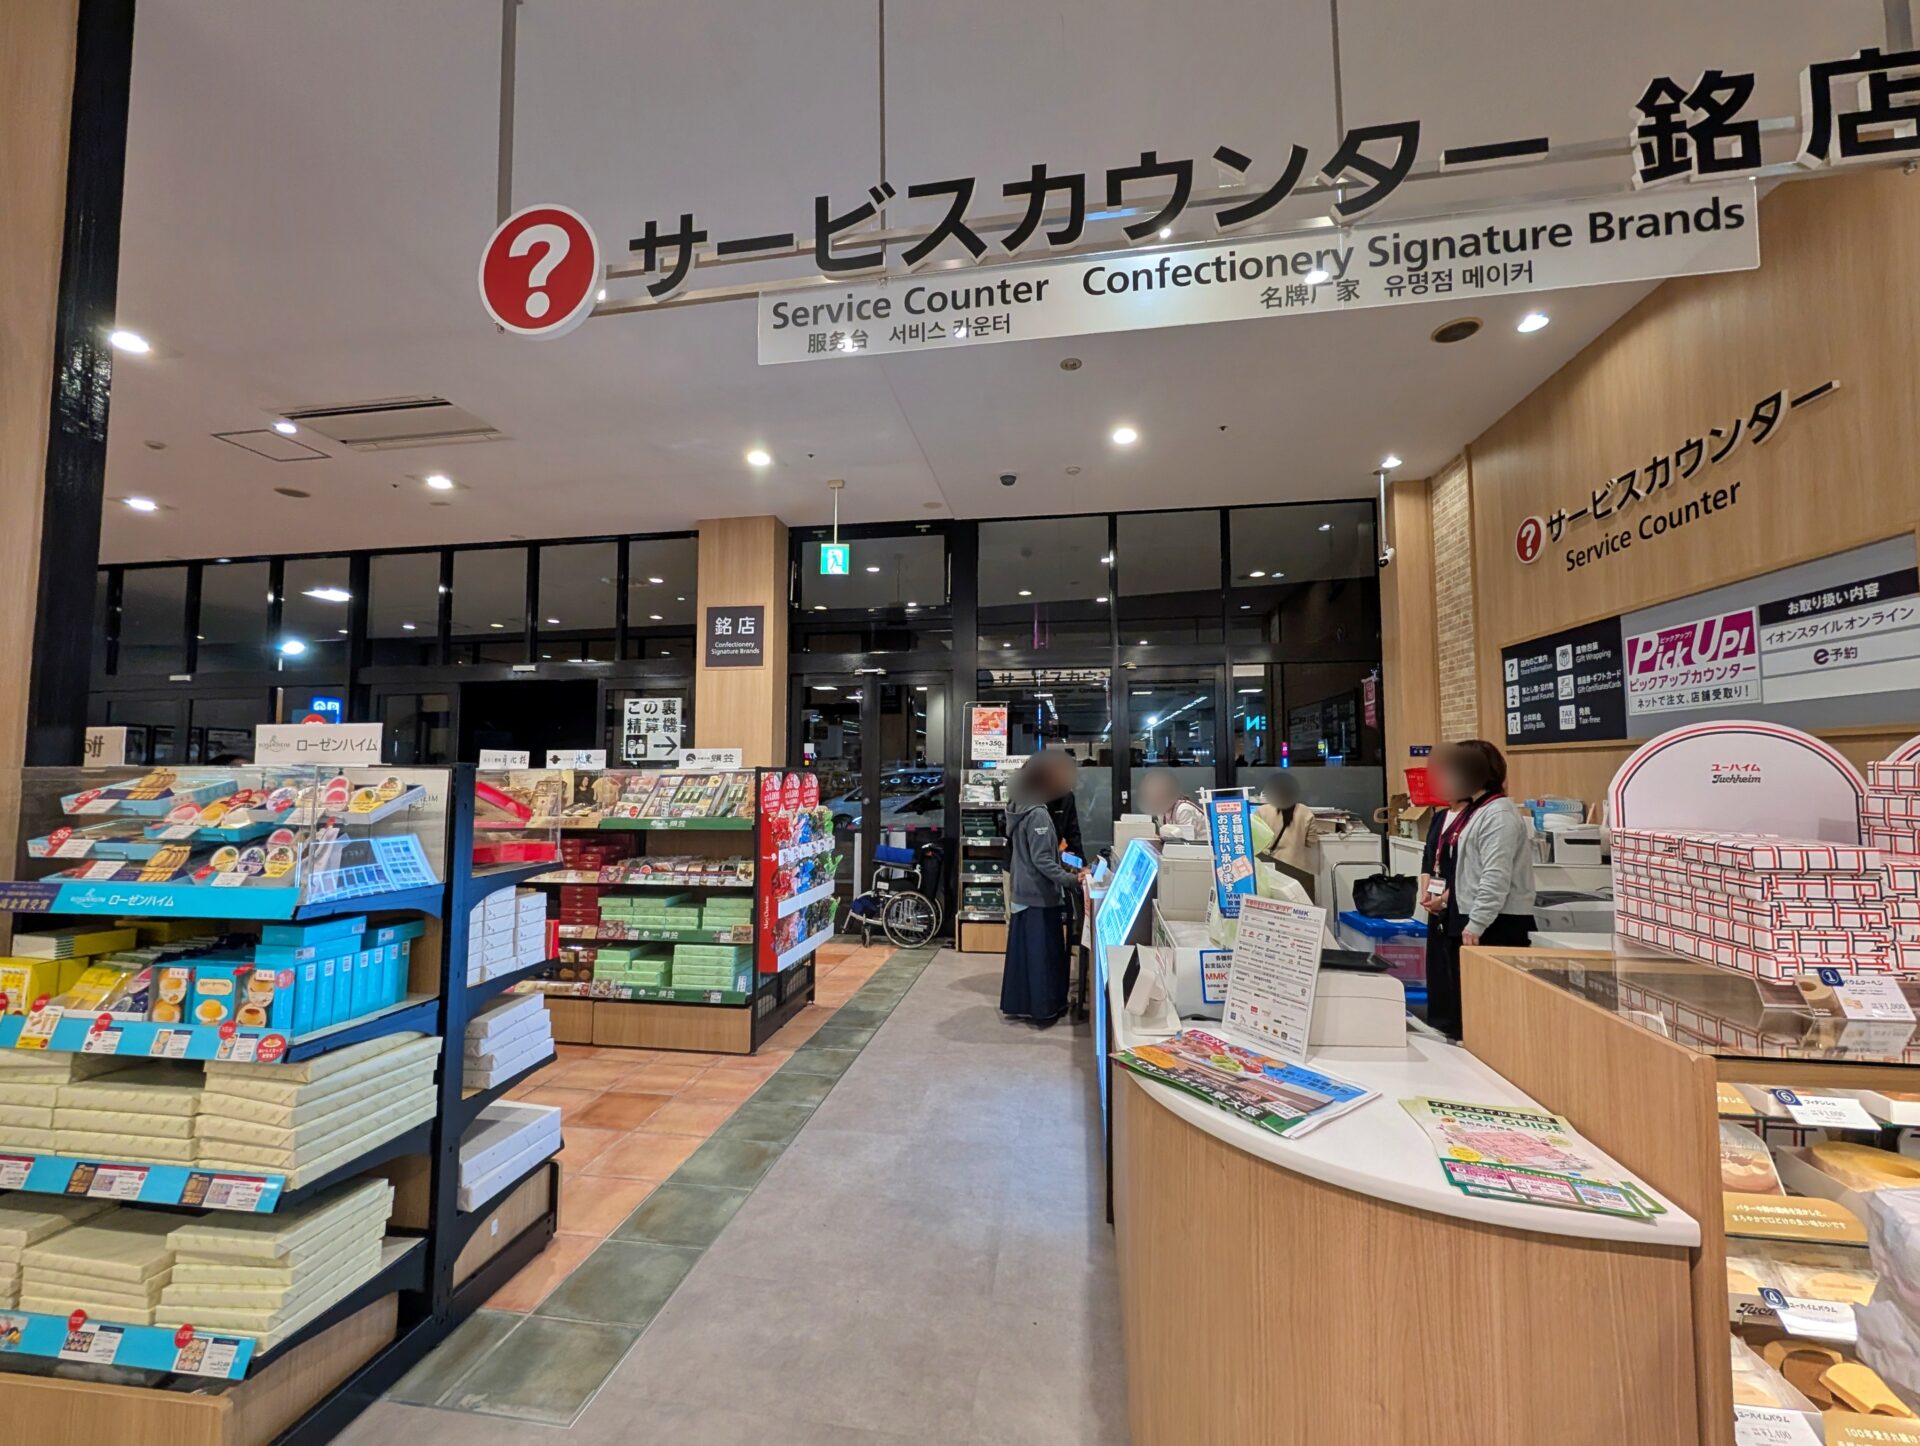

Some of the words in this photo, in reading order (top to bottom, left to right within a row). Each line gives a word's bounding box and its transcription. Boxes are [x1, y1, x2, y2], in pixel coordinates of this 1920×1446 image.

[629, 119, 1549, 298] サービスカウンター
[1634, 47, 1920, 184] 銘店
[772, 292, 891, 329] Service
[903, 273, 1049, 314] Counter
[1083, 245, 1354, 296] Confectionery
[1368, 221, 1573, 272] Signature
[1589, 197, 1745, 243] Brands
[1384, 270, 1453, 297] 유명점
[1462, 260, 1534, 288] 메이커
[1261, 279, 1360, 309] 名牌厂家
[807, 331, 869, 354] 服务台
[889, 320, 946, 345] 서비스
[953, 313, 1012, 338] 카운터
[1546, 381, 1838, 542] サービスカウンター
[1565, 531, 1631, 571] Service
[1638, 480, 1741, 540] Counter
[1787, 582, 1879, 615] お取り扱い内容
[715, 616, 755, 635] 銘店
[1766, 607, 1914, 645] イオンスタイルオンライン
[1630, 664, 1756, 692] ピックアップカウンター
[628, 700, 677, 715] この裏
[627, 717, 678, 733] 精算機
[296, 737, 378, 753] ローゼンハイム
[1711, 763, 1760, 772] ユーハイム
[1712, 774, 1761, 784] Juchheim
[1232, 814, 1245, 854] 各種料金
[1217, 815, 1234, 892] お支払い承ります
[108, 895, 174, 907] ローゼンハイム
[1136, 1058, 1263, 1117] イオンスタイル東大阪
[1430, 1108, 1495, 1123] FLOOR
[1502, 1118, 1564, 1132] GUIDE
